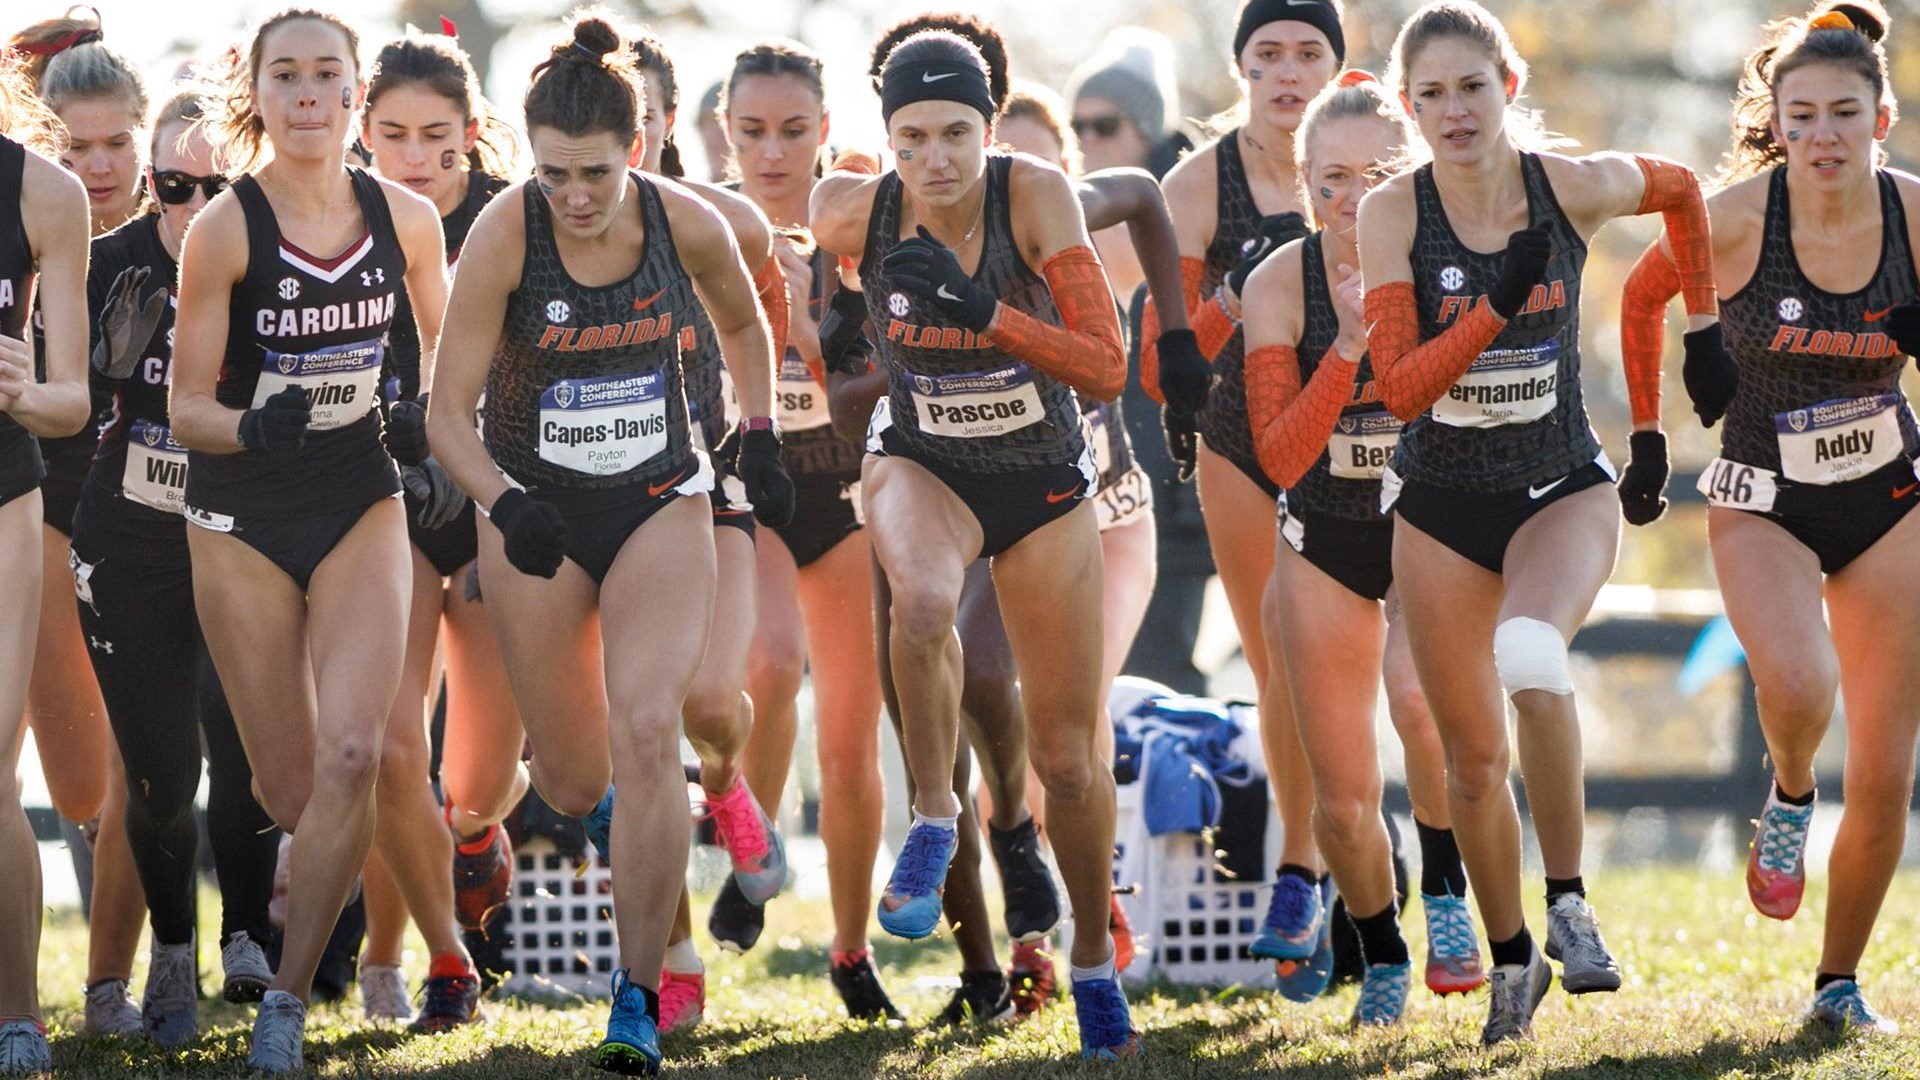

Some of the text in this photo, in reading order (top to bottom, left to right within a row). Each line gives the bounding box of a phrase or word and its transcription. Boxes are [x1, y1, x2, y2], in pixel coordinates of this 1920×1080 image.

[278, 277, 300, 300] SEC
[1440, 267, 1464, 290] SEC
[256, 292, 395, 338] CAROLINA
[546, 300, 570, 323] SEC
[1779, 298, 1803, 322] SEC
[537, 312, 672, 351] FLORIDA
[302, 357, 364, 370] CONFERENCE
[304, 346, 375, 362] SOUTHEASTERN
[580, 375, 656, 393] SOUTHEASTERN
[580, 386, 646, 402] CONFERENCE
[939, 379, 1006, 390] CONFERENCE
[926, 399, 1027, 424] Pascoe
[1812, 401, 1878, 423] CONFERENCE
[544, 414, 665, 447] Capes-Davis
[962, 424, 1004, 435] Jessica
[588, 449, 627, 463] Payton
[1815, 429, 1874, 463] Addy
[594, 463, 621, 471] Florida
[1101, 470, 1147, 523] 152
